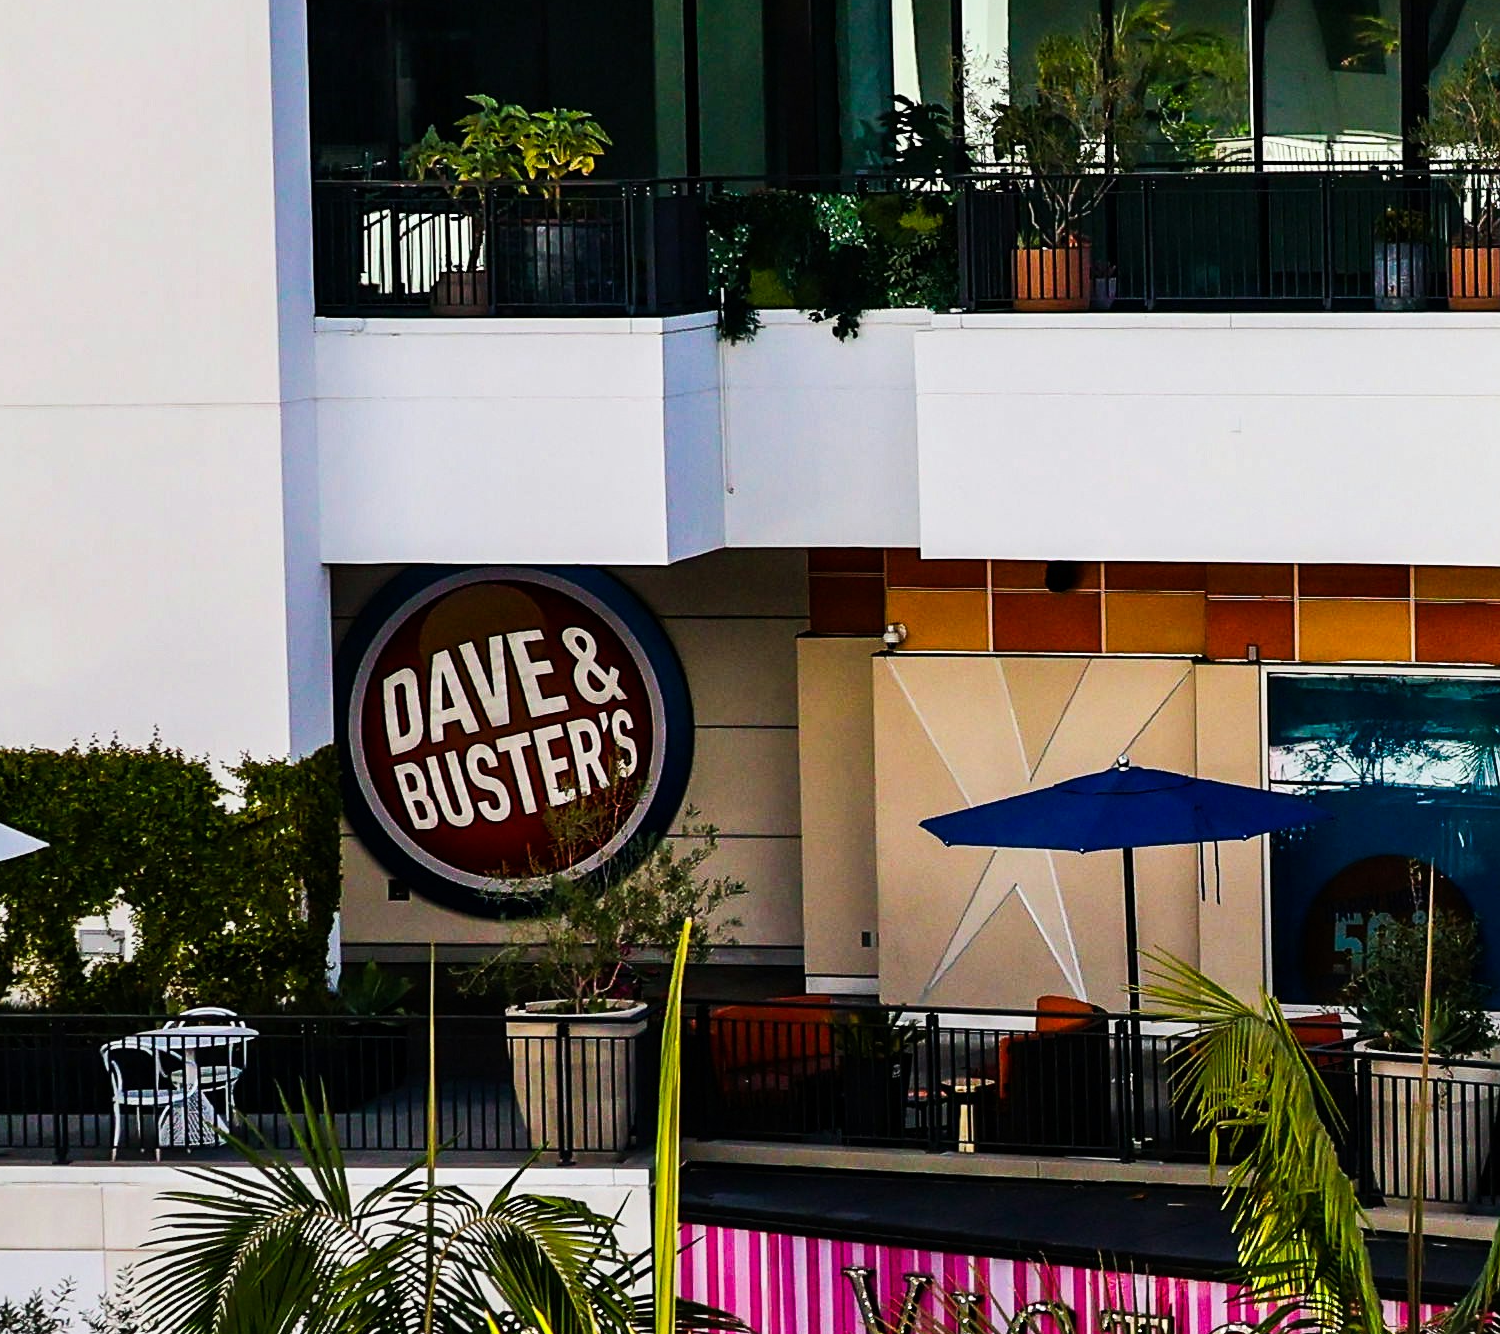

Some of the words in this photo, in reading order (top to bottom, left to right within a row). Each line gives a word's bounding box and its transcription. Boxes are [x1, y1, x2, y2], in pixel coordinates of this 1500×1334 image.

[382, 628, 569, 757] DAVE
[560, 625, 629, 705] &
[393, 708, 639, 831] BUSTER'S
